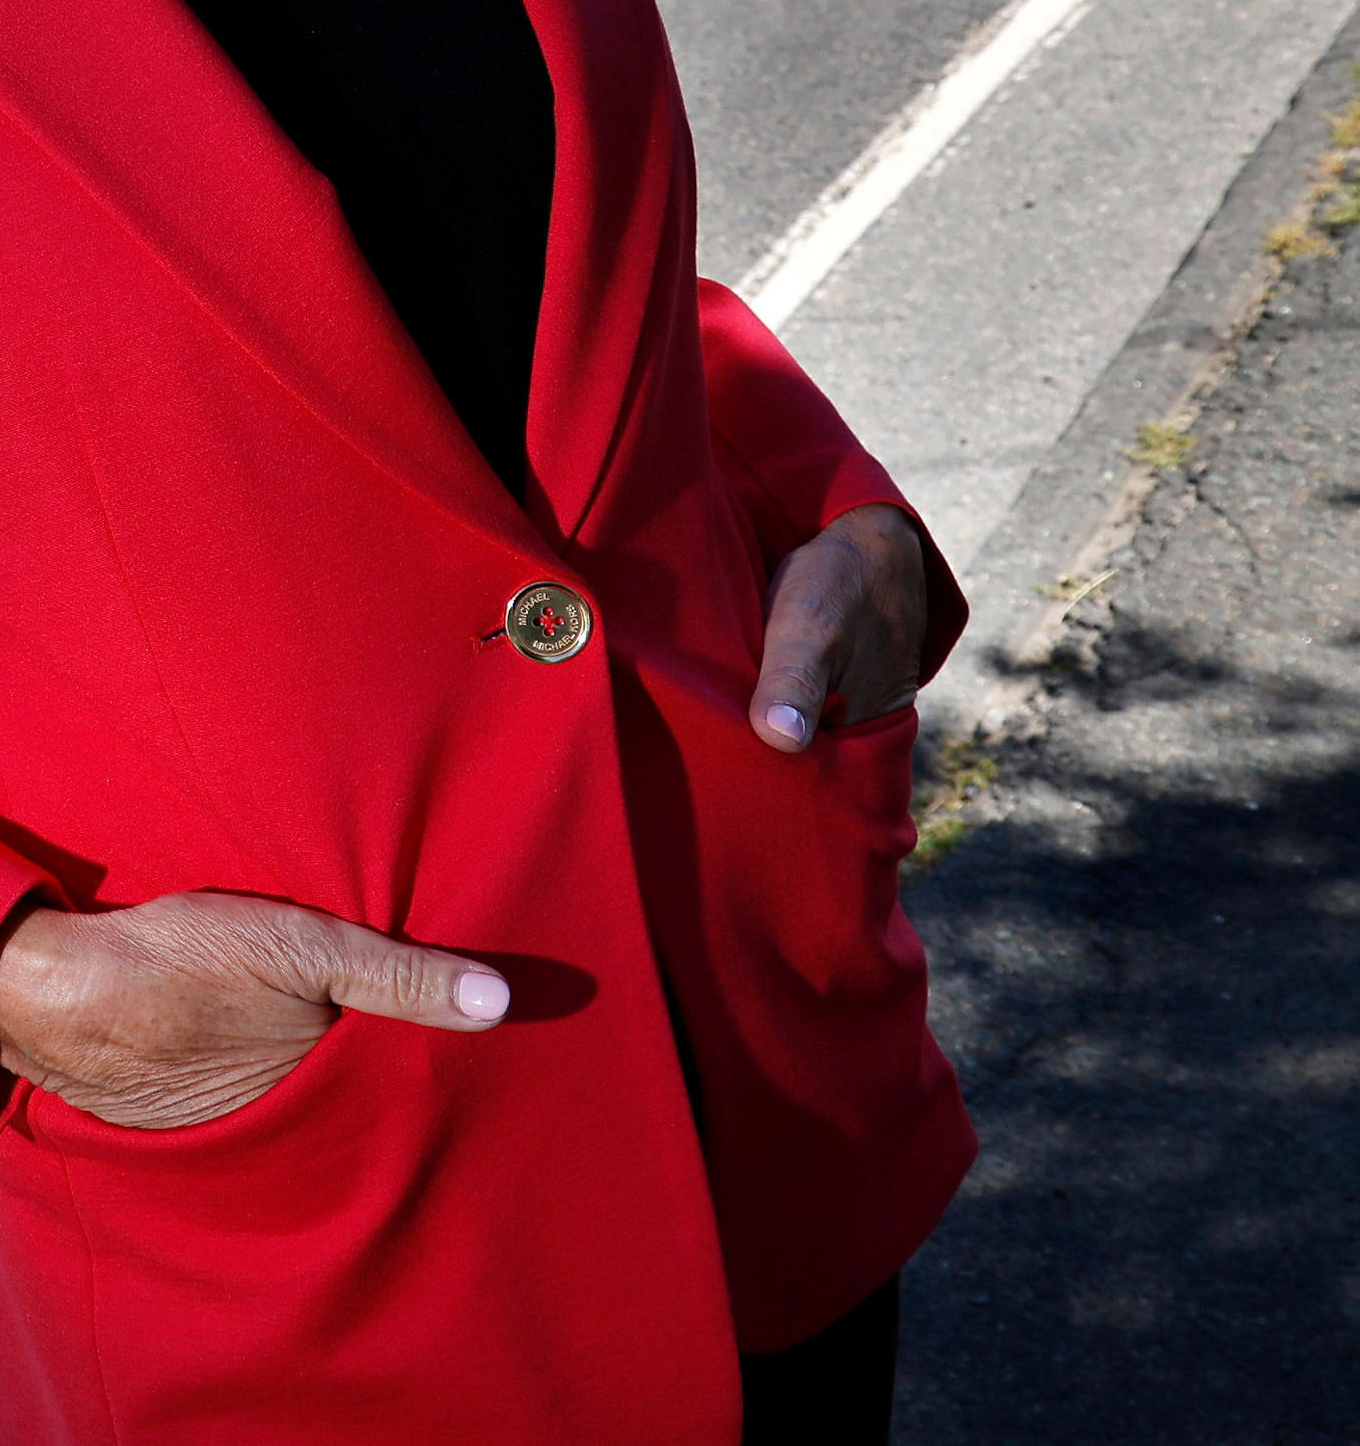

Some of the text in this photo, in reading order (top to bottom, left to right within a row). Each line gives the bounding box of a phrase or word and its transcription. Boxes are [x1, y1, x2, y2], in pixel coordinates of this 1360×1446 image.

[518, 592, 550, 626] MICHAEL
[532, 604, 579, 651] MICHAEL KORS
